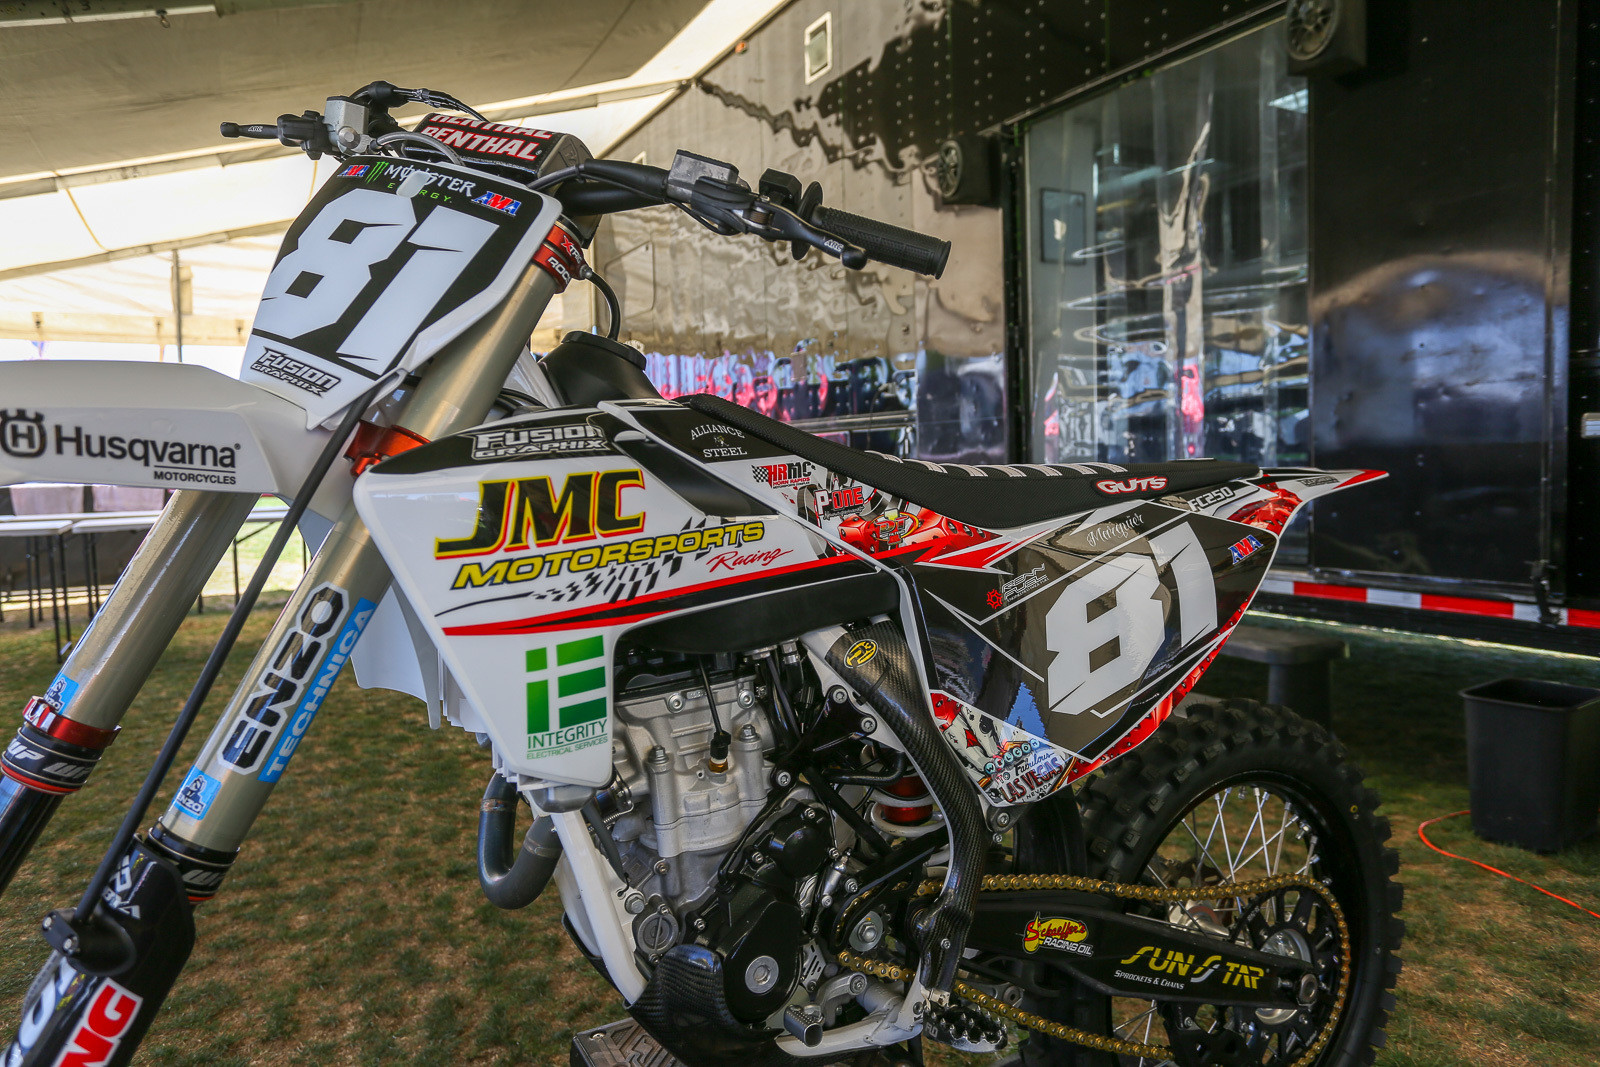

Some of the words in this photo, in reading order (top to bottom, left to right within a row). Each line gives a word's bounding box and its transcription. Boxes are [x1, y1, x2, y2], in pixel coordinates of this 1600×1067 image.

[337, 165, 369, 177] AMA
[385, 164, 477, 197] MOSTER
[387, 182, 451, 202] ERGY
[471, 191, 522, 216] AMA
[252, 188, 500, 376] 81
[251, 363, 322, 396] GRAPHIX
[259, 349, 341, 390] FUSION
[476, 425, 603, 449] FUSION
[691, 424, 745, 440] ALLIANCE
[55, 425, 236, 468] Husqvarna
[475, 440, 608, 458] GRAPHIX
[703, 447, 748, 458] STEEL
[154, 470, 237, 485] MOTORCYCLES
[1096, 476, 1168, 495] GUTS
[434, 468, 646, 560] JMC
[450, 521, 765, 590] MOTORSPORTS
[706, 549, 794, 572] Racing
[1228, 534, 1265, 565] AMA
[1045, 521, 1218, 715] 81
[219, 584, 347, 772] ENZO
[527, 718, 608, 750] INTEGRITY
[526, 746, 573, 760] ELECTRICAL
[575, 736, 609, 751] SERVICES
[1026, 782, 1053, 799] NEVADA
[1043, 936, 1079, 952] RACING
[1077, 944, 1092, 955] OIL
[1152, 977, 1159, 985] &
